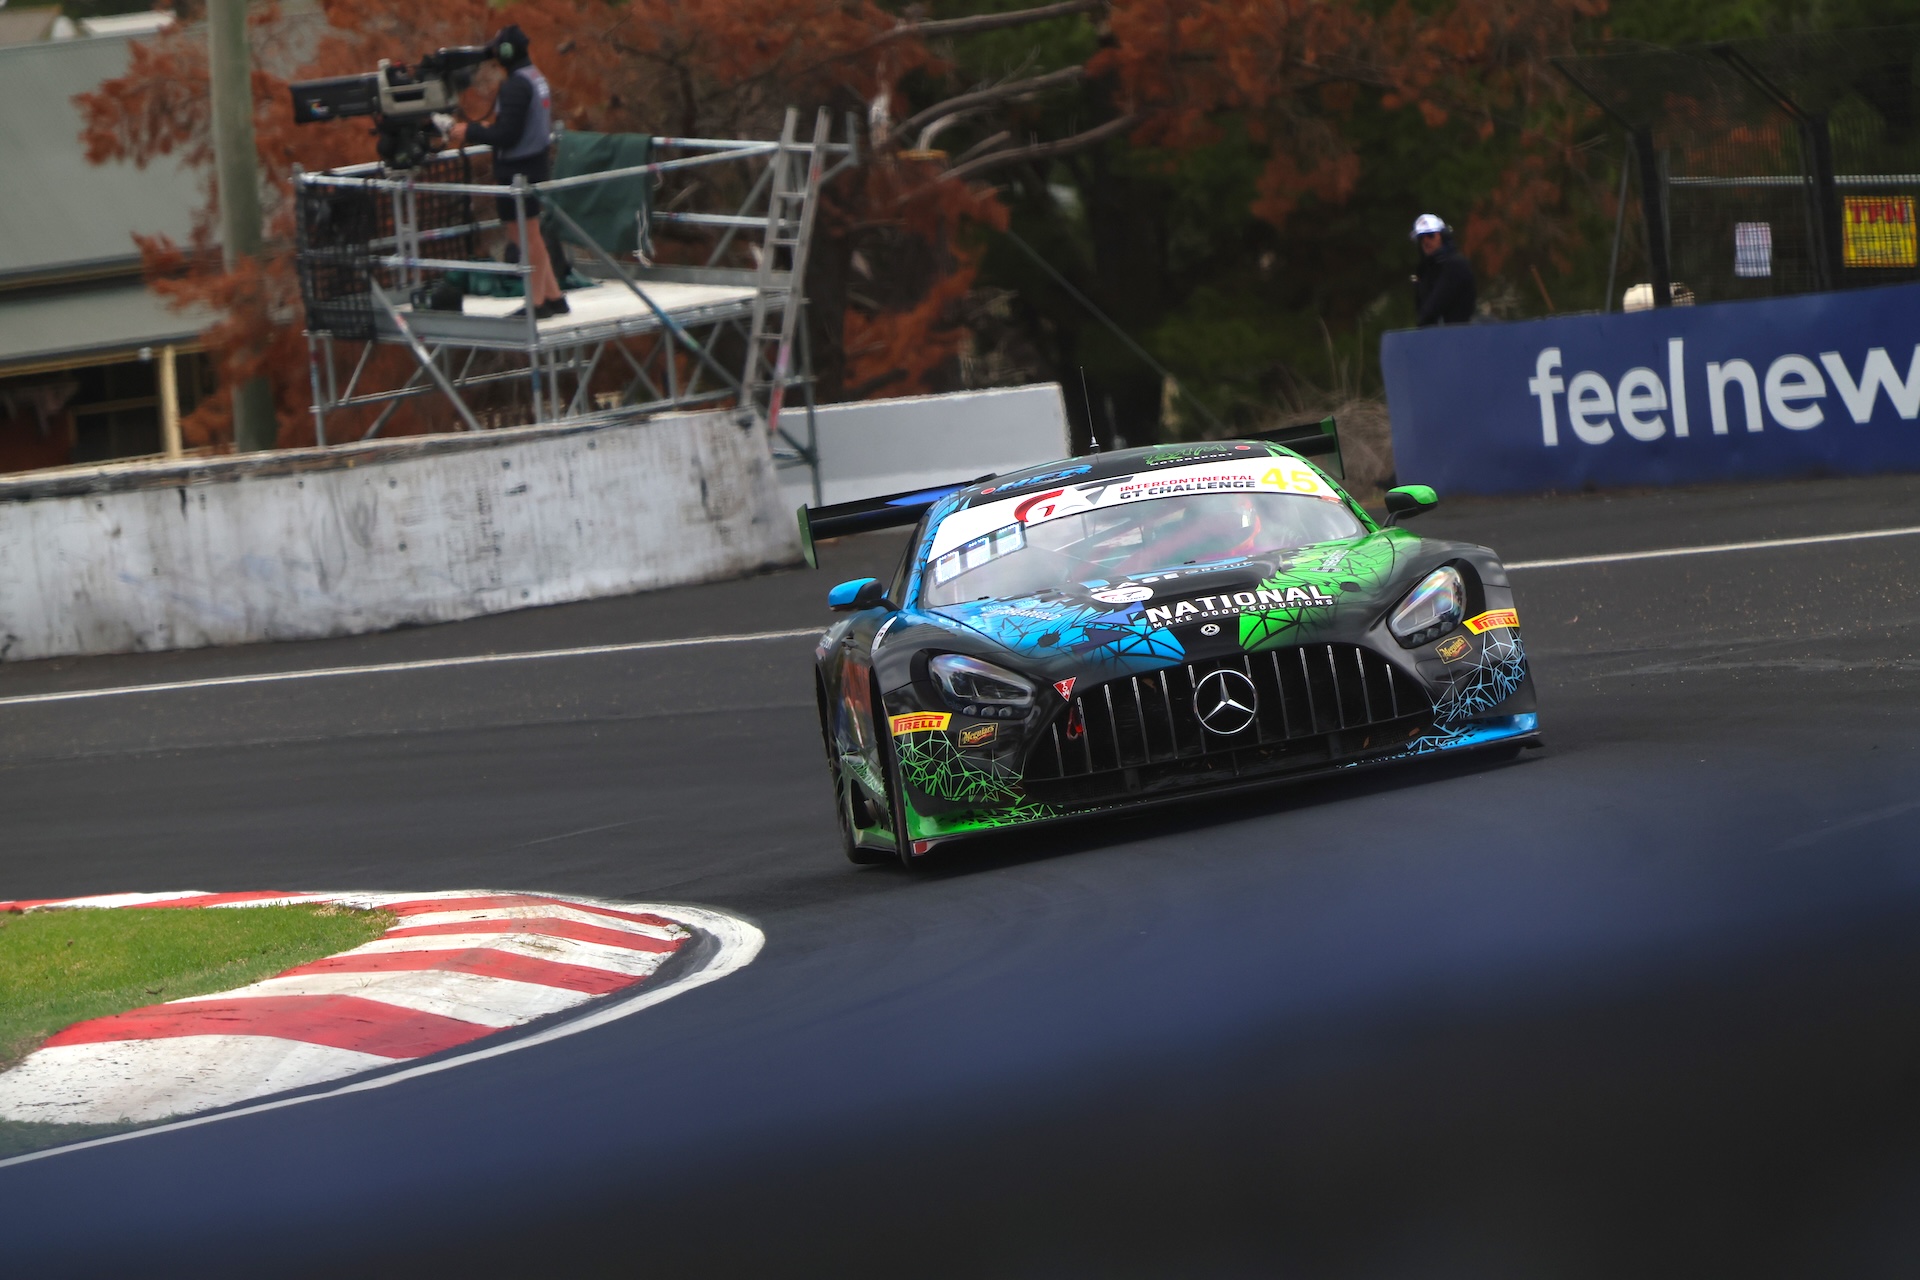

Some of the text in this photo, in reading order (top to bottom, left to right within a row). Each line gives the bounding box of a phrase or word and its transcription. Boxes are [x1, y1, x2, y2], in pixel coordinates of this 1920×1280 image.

[1529, 337, 1920, 446] feel new
[1120, 475, 1255, 492] INTERCONTINENTAL
[1120, 481, 1256, 500] GT CHALLENGE
[1261, 467, 1319, 493] 45
[1145, 586, 1333, 623] NATIONAL
[1152, 599, 1334, 629] MAKE GOOD SOLUTIONS
[1472, 612, 1518, 631] PIRELLI
[893, 714, 944, 733] PIRELLI
